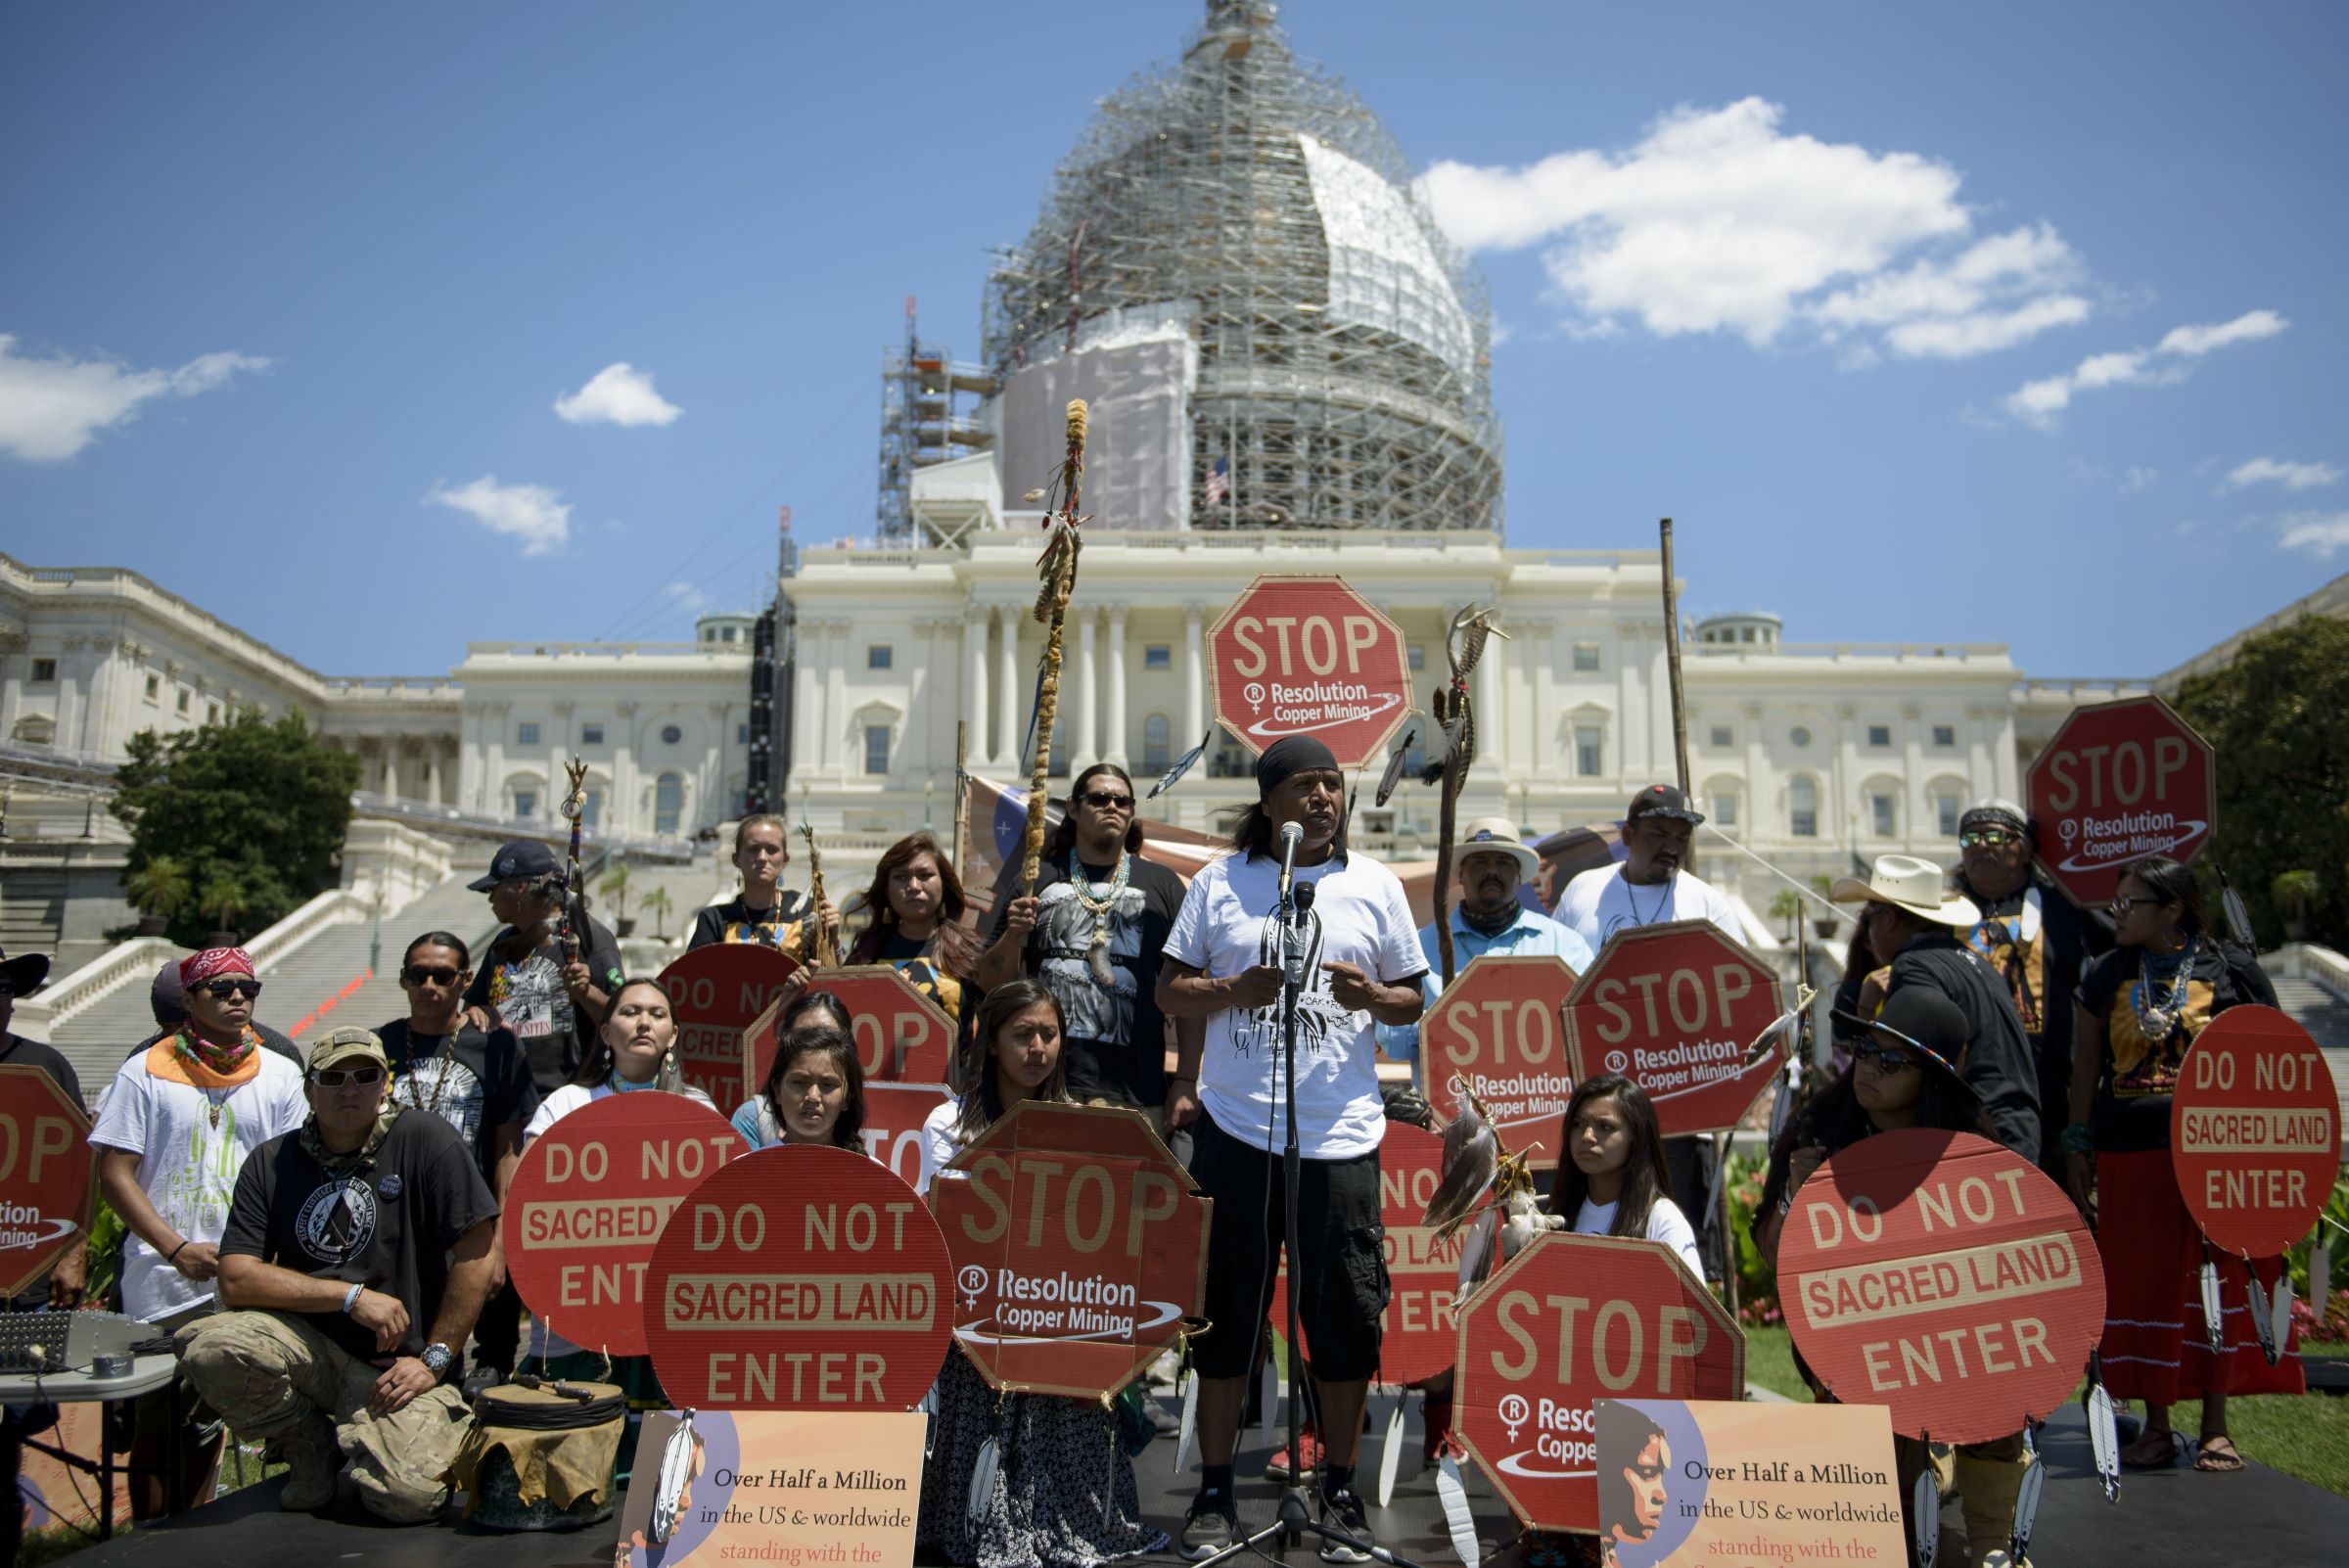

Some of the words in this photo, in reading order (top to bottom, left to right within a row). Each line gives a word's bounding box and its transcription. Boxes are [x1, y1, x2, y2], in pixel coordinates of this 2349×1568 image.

[1233, 616, 1378, 677] STOP
[1270, 681, 1368, 704] Resolution
[1273, 706, 1322, 725] Copper
[1324, 703, 1371, 720] Mining
[2049, 736, 2188, 812] STOP
[2083, 809, 2175, 838] Resolution
[2083, 840, 2128, 859] Copper
[2131, 834, 2175, 852] Mining
[667, 975, 714, 1010] DO
[1305, 996, 1325, 1006] OAK
[1594, 963, 1752, 1042] STOP
[681, 1029, 743, 1057] CRED
[852, 1012, 929, 1076] OP
[1446, 999, 1558, 1065] STO
[1634, 1038, 1738, 1070] Resolution
[2195, 1050, 2235, 1090] DO
[2255, 1052, 2318, 1091] NOT
[1476, 1072, 1573, 1096] Resolution
[1637, 1070, 1688, 1090] Copper
[1692, 1062, 1742, 1082] Mining
[2186, 1114, 2267, 1145] SACRED
[2274, 1116, 2327, 1145] LAND
[546, 1141, 609, 1182] DO
[642, 1136, 735, 1179] NOT
[960, 1155, 1178, 1257] STOP
[1380, 1168, 1441, 1209] NO
[2206, 1170, 2307, 1209] ENTER
[529, 1205, 658, 1241] SACRED
[1806, 1195, 1882, 1250] DO
[1914, 1168, 2025, 1232] NOT
[694, 1203, 766, 1252] DO
[805, 1203, 914, 1252] NOT
[1408, 1233, 1464, 1266] LAN
[561, 1262, 650, 1307] ENT
[997, 1268, 1135, 1307] Resolution
[1808, 1262, 1959, 1318] SACRED
[1967, 1241, 2071, 1293] LAND
[673, 1282, 821, 1321] SACRED
[834, 1282, 928, 1321] LAND
[995, 1303, 1064, 1332] Copper
[1068, 1307, 1134, 1339] Mining
[1491, 1290, 1708, 1394] STOP
[1862, 1317, 2056, 1392] ENTER
[708, 1353, 887, 1402] ENTER
[1537, 1433, 1596, 1465] Coppe
[714, 1468, 763, 1489] Over
[768, 1469, 816, 1489] Half
[817, 1476, 828, 1489] a
[833, 1471, 907, 1491] Million
[1684, 1460, 1735, 1481] Over
[1742, 1462, 1789, 1483] Half
[1794, 1470, 1805, 1483] a
[1811, 1464, 1888, 1485] Million
[700, 1505, 718, 1523] in
[722, 1503, 753, 1524] the
[759, 1506, 787, 1525] US
[792, 1508, 808, 1525] &
[812, 1507, 911, 1528] worldwide
[1680, 1499, 1698, 1518] in
[1703, 1499, 1734, 1518] the
[1739, 1499, 1769, 1519] US
[1774, 1503, 1792, 1520] &
[1796, 1501, 1900, 1523] worldwide
[720, 1541, 801, 1567] standing
[806, 1544, 847, 1562] with
[852, 1545, 882, 1564] the
[1708, 1536, 1794, 1562] standing
[1798, 1538, 1839, 1558] with
[1846, 1539, 1877, 1559] the
